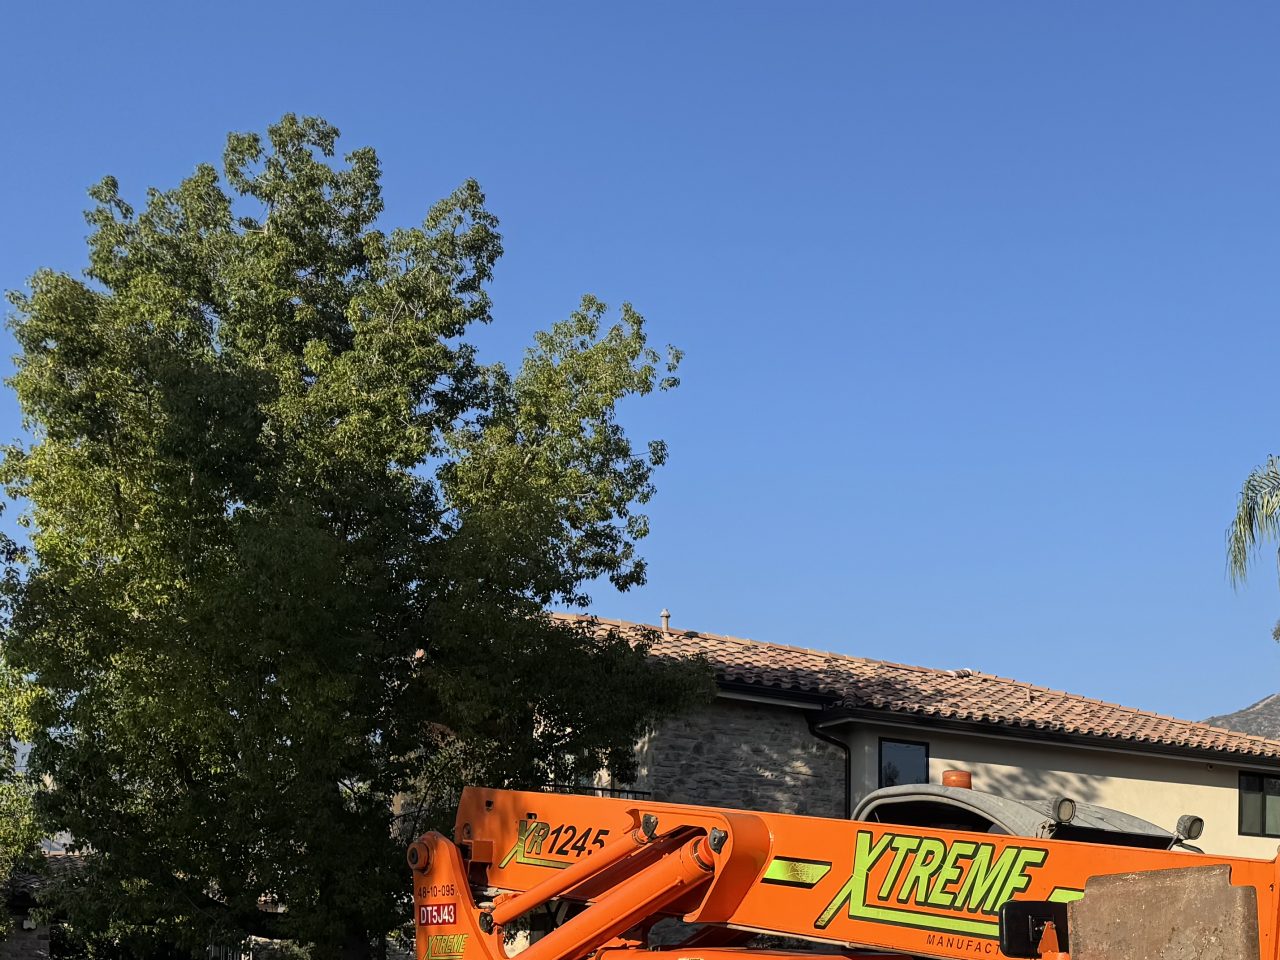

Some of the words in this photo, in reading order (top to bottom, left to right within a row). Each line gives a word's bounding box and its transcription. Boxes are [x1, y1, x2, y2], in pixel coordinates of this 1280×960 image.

[814, 830, 1049, 930] XTREME
[420, 904, 455, 924] DT5J43
[926, 934, 1000, 955] MANUFACT
